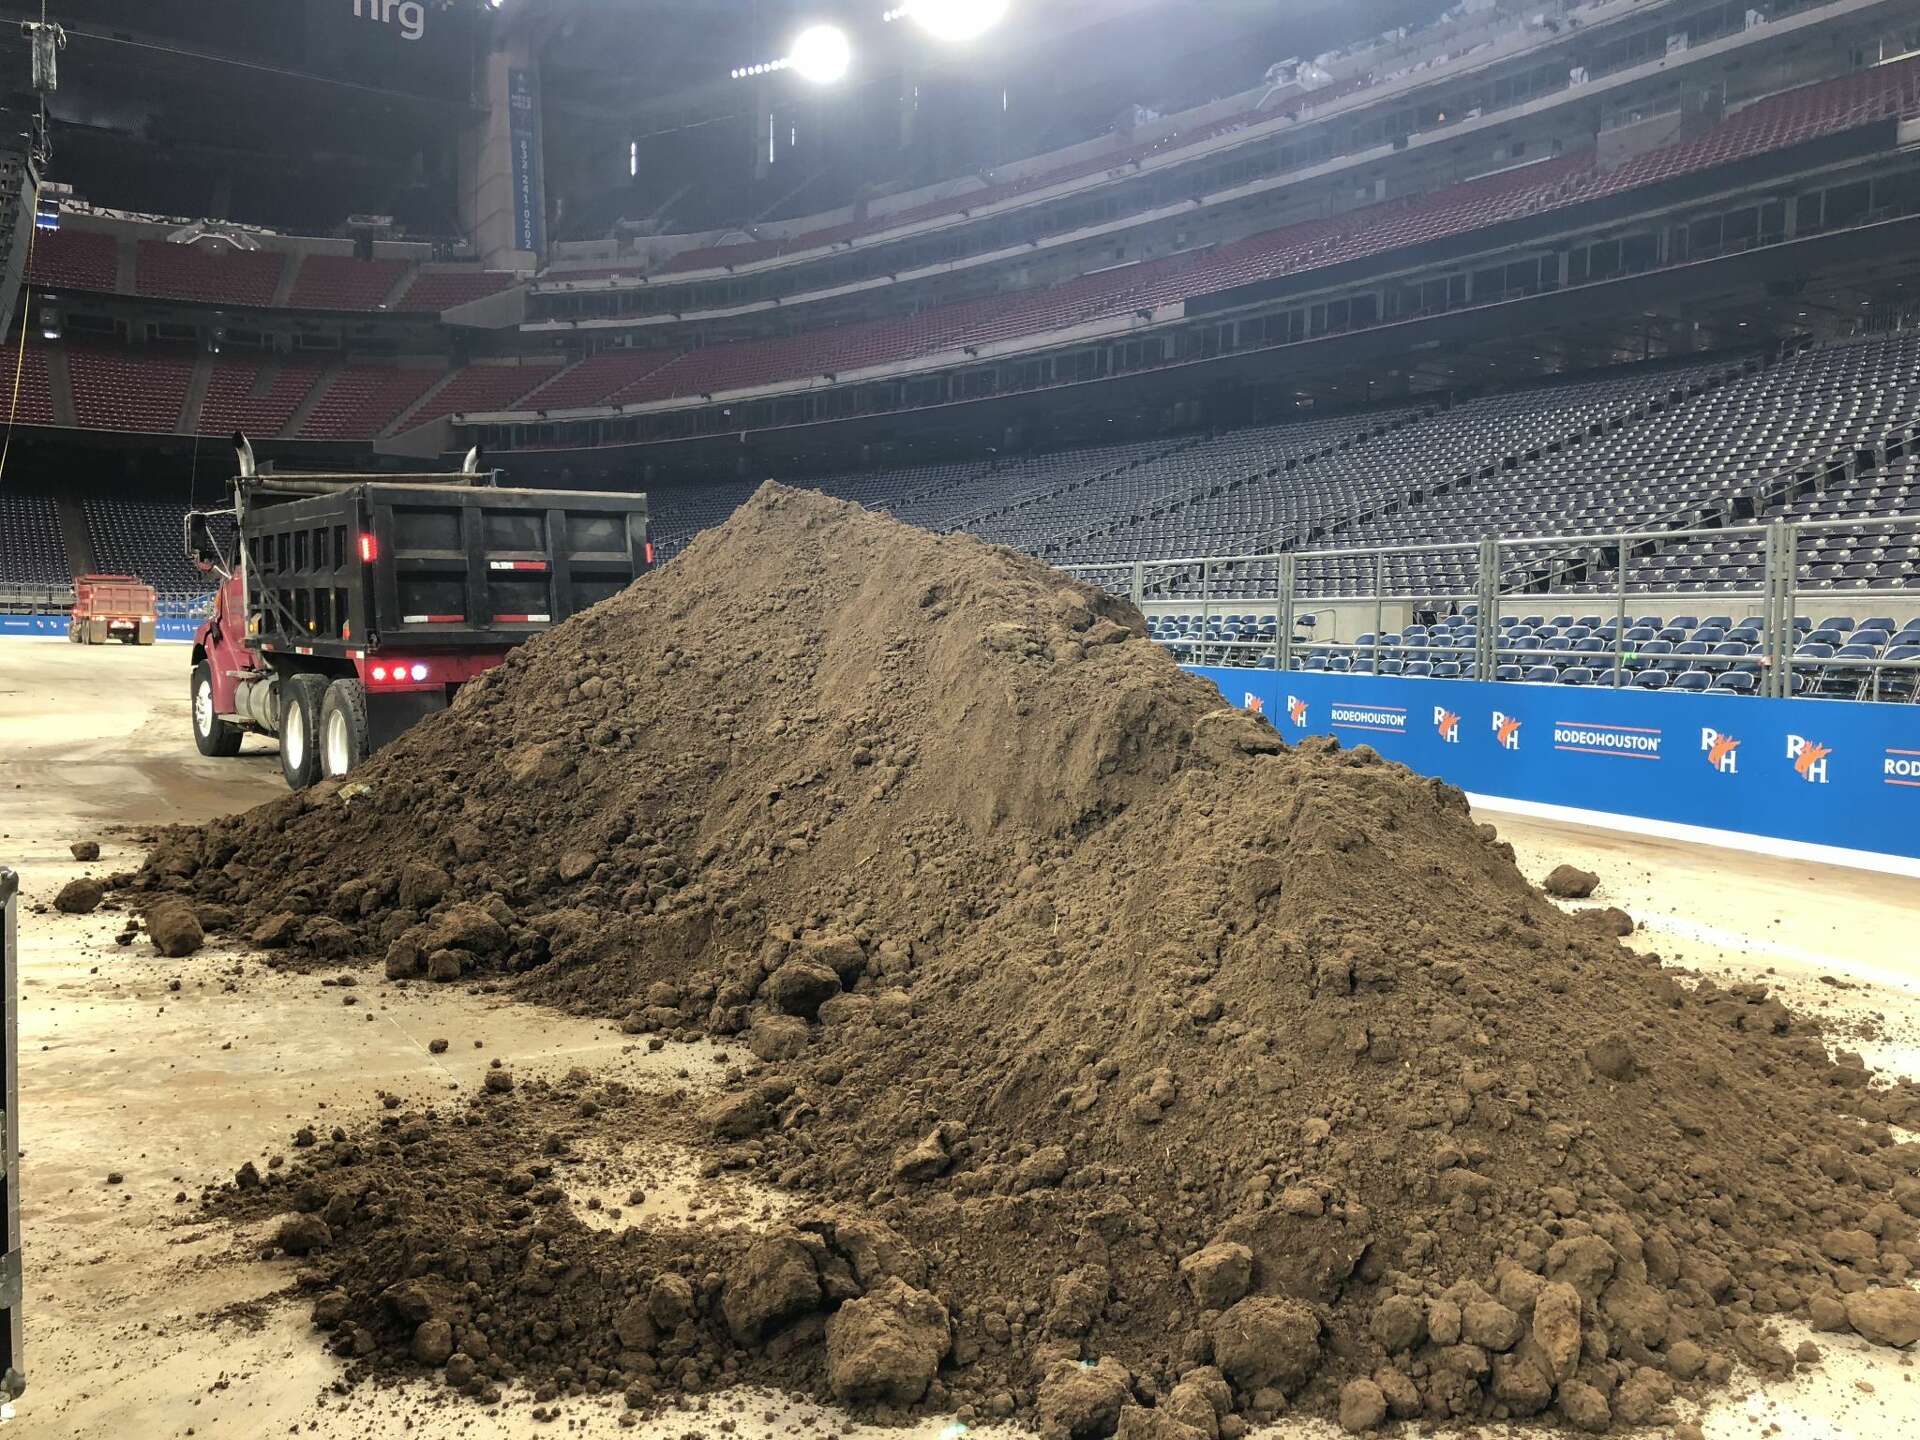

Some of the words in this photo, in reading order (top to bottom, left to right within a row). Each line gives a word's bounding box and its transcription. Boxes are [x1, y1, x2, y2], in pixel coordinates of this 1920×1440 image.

[353, 0, 424, 40] nrg
[1331, 709, 1405, 726] RODEOHOUSTON
[1554, 729, 1659, 752] RODEOHOUSTON
